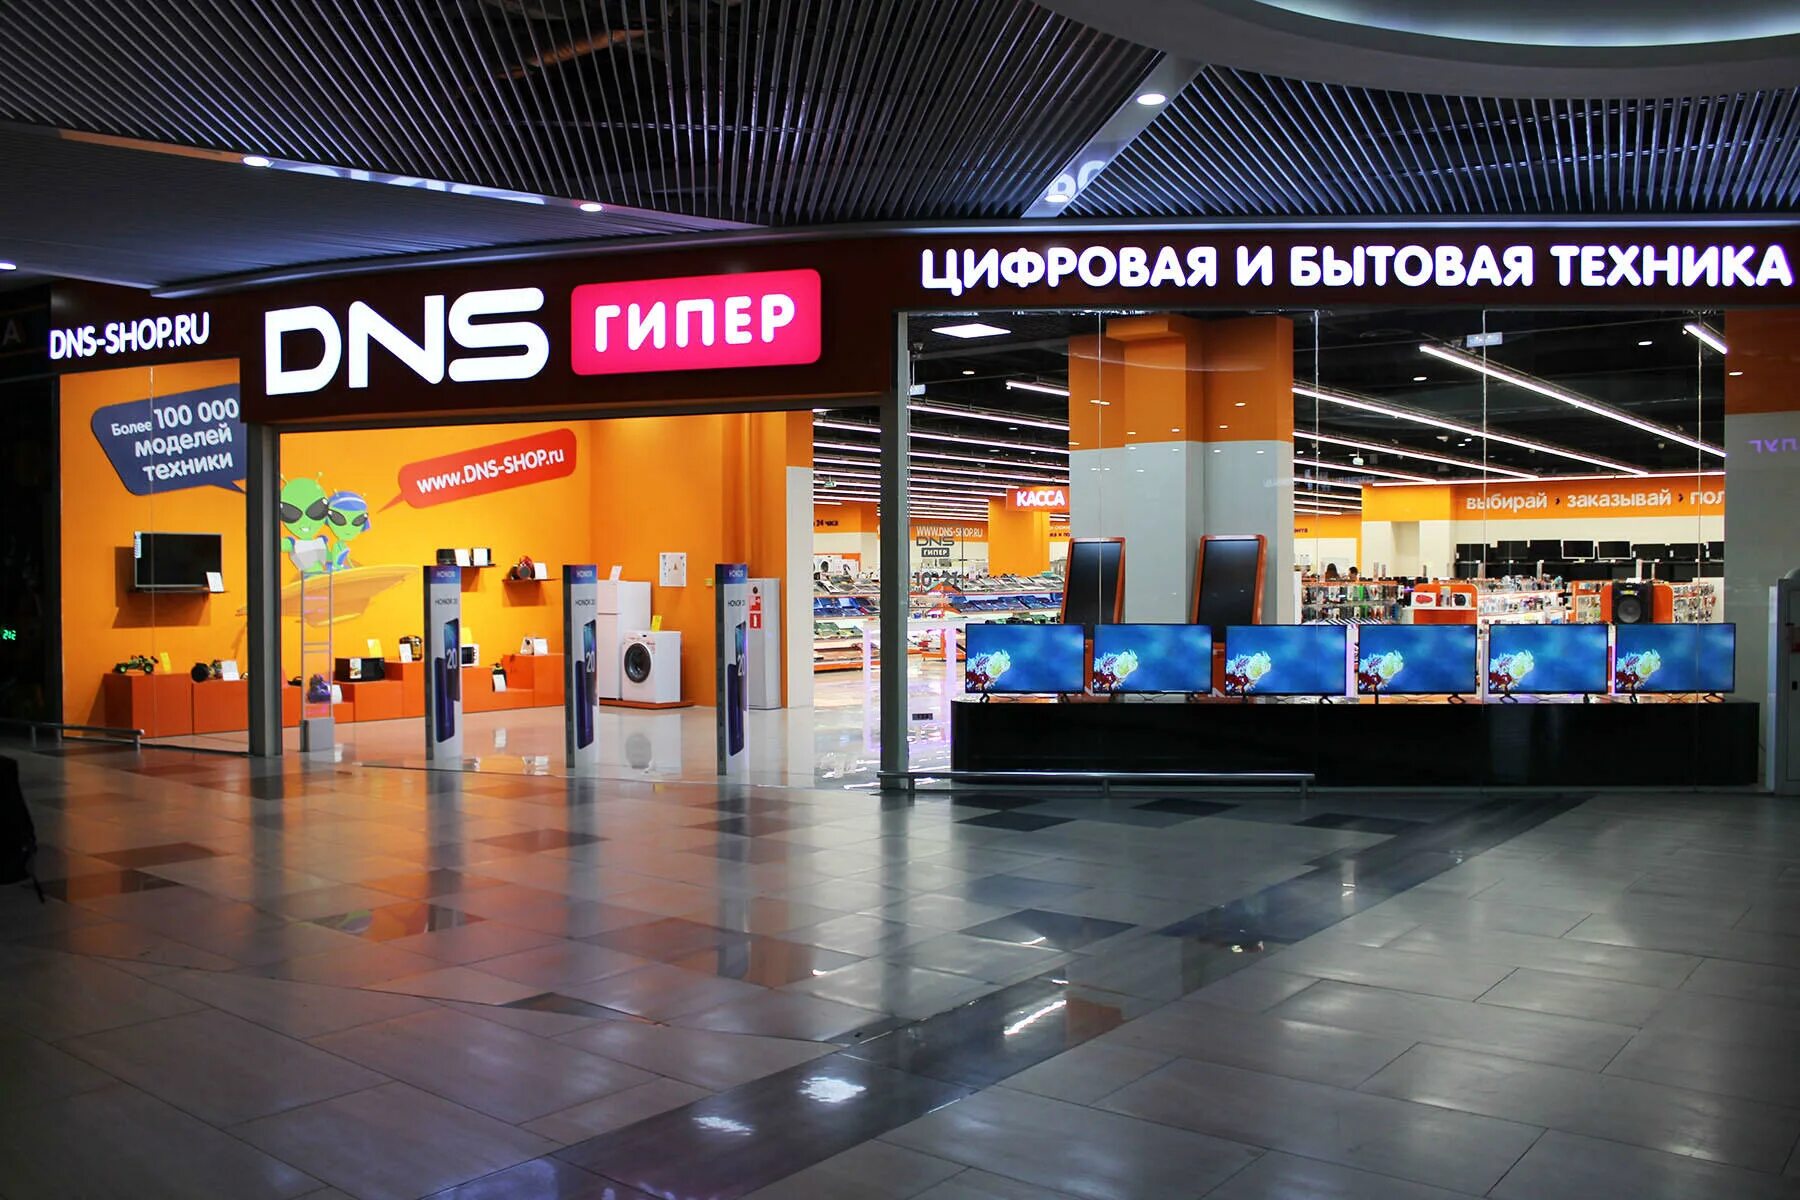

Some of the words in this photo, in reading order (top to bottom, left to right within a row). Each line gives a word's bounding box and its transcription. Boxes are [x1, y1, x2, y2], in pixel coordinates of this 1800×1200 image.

[922, 246, 1217, 297] ЦИФРОВАЯ
[1236, 244, 1273, 287] И
[1289, 245, 1535, 287] БЫТОВАЯ
[1549, 244, 1794, 288] ТЕХНИКА
[49, 311, 211, 361] DNS-SHOP.RU
[264, 287, 550, 396] DNS
[595, 293, 796, 353] ГИПЕР
[111, 421, 152, 437] Более
[153, 403, 193, 430] 100
[197, 397, 240, 423] 000
[134, 422, 233, 458] моделей
[142, 451, 234, 482] техники
[416, 448, 565, 494] www.DNS-SHOP.ru
[1016, 489, 1066, 507] КАССА
[1466, 492, 1548, 513] выбирай
[1566, 488, 1672, 509] заказывай
[916, 536, 955, 547] DNS
[446, 647, 458, 670] 20
